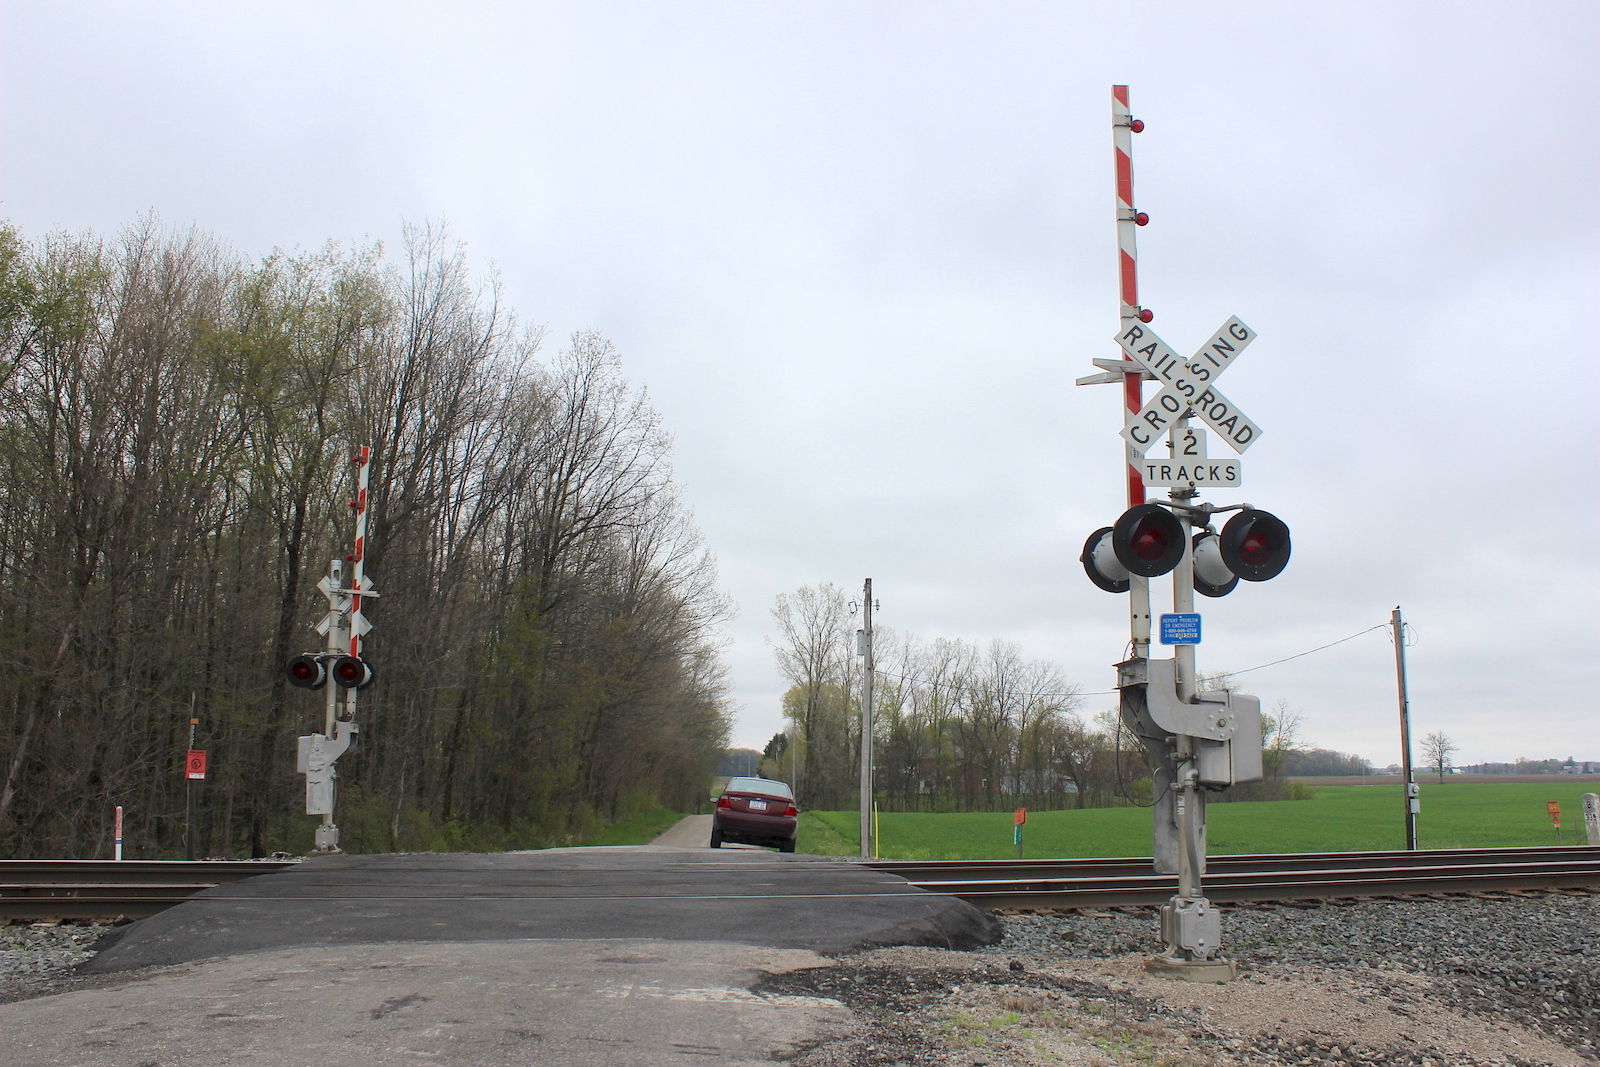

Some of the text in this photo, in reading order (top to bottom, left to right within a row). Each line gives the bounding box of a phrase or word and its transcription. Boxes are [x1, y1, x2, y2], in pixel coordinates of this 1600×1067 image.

[1123, 325, 1253, 445] RAIL ROAD
[1130, 323, 1248, 445] CROSSING
[1146, 465, 1236, 481] TRACKS
[1183, 435, 1198, 455] 2
